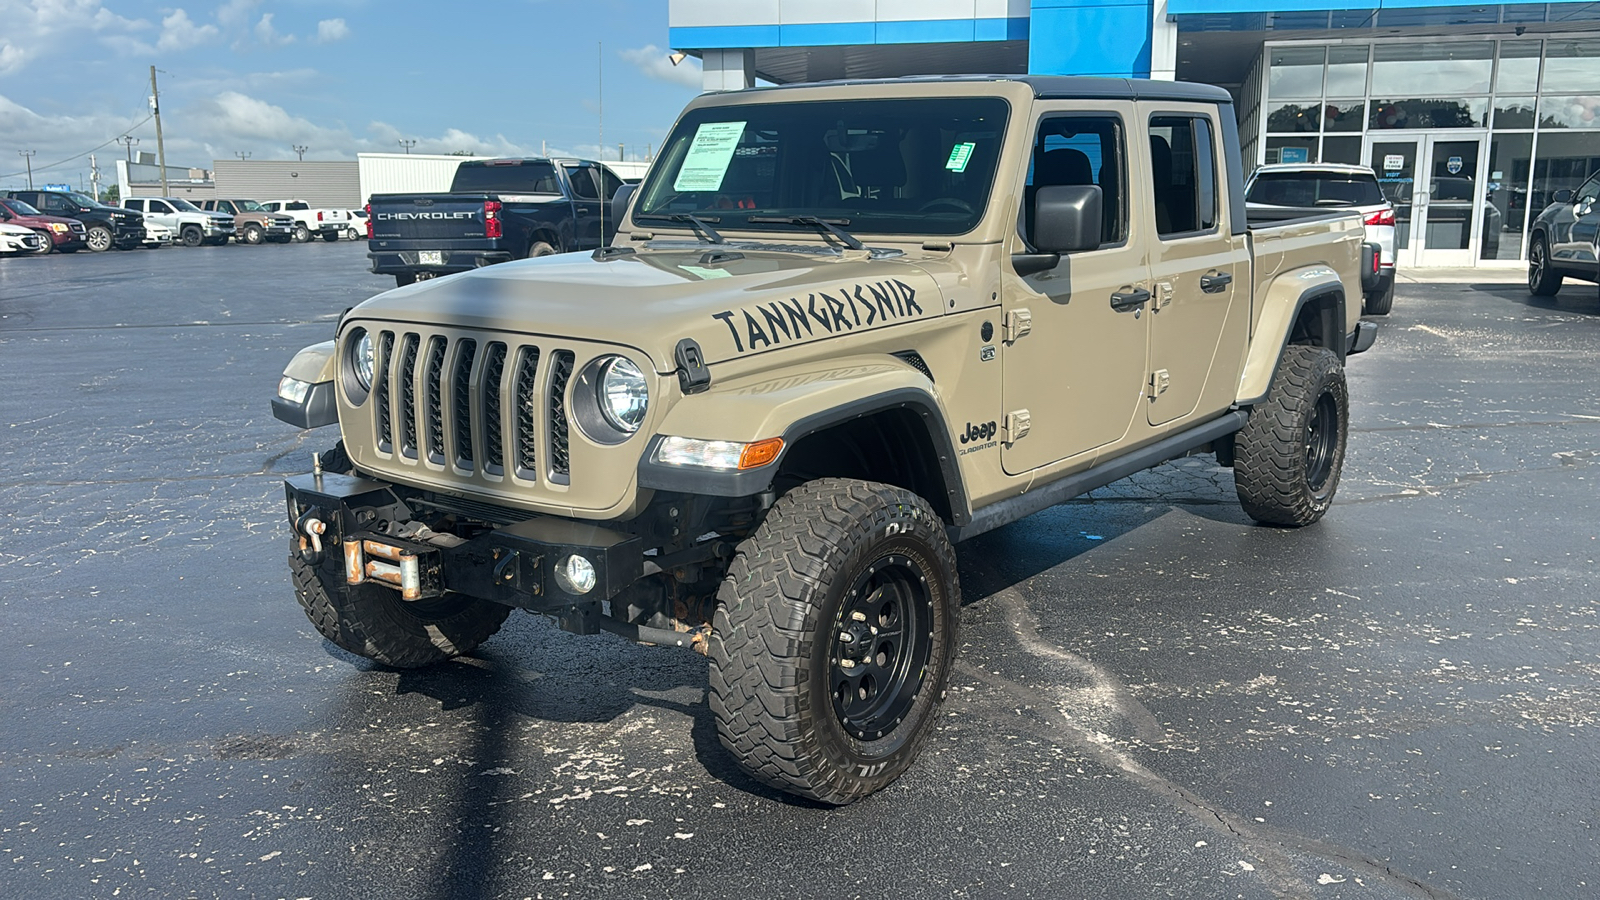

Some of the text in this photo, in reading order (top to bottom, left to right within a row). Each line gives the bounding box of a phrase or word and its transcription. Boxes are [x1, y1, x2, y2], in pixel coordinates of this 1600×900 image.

[378, 211, 475, 220] CHEVROLET
[711, 278, 923, 352] TANNGRISNIR
[960, 421, 997, 444] Jeep
[959, 441, 997, 455] GLADIATOR
